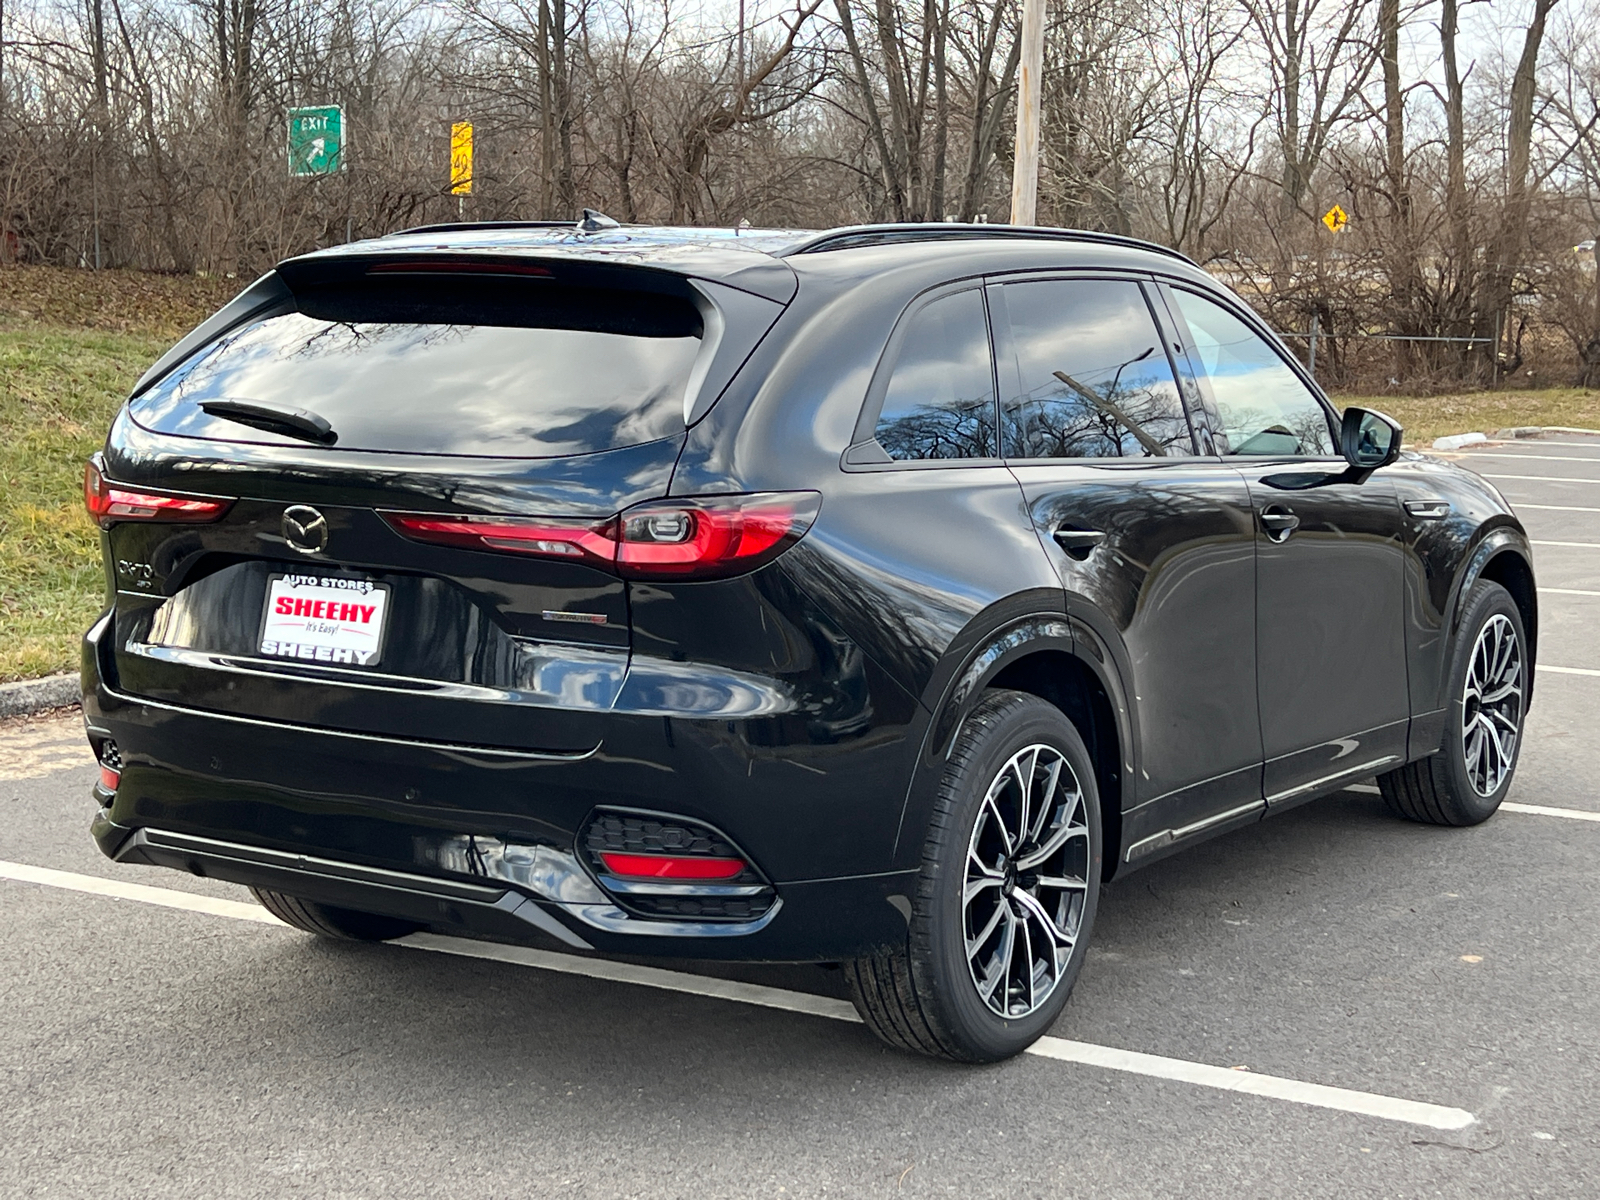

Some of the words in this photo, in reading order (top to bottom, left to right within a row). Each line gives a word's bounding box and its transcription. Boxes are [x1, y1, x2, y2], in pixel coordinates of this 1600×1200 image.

[301, 116, 329, 131] EXIT
[282, 574, 318, 586] AUTO
[320, 577, 374, 592] STORES
[275, 596, 377, 624] SHEEHY
[305, 621, 318, 633] It's
[318, 623, 340, 636] Easy!
[260, 640, 374, 666] SHEEHY
